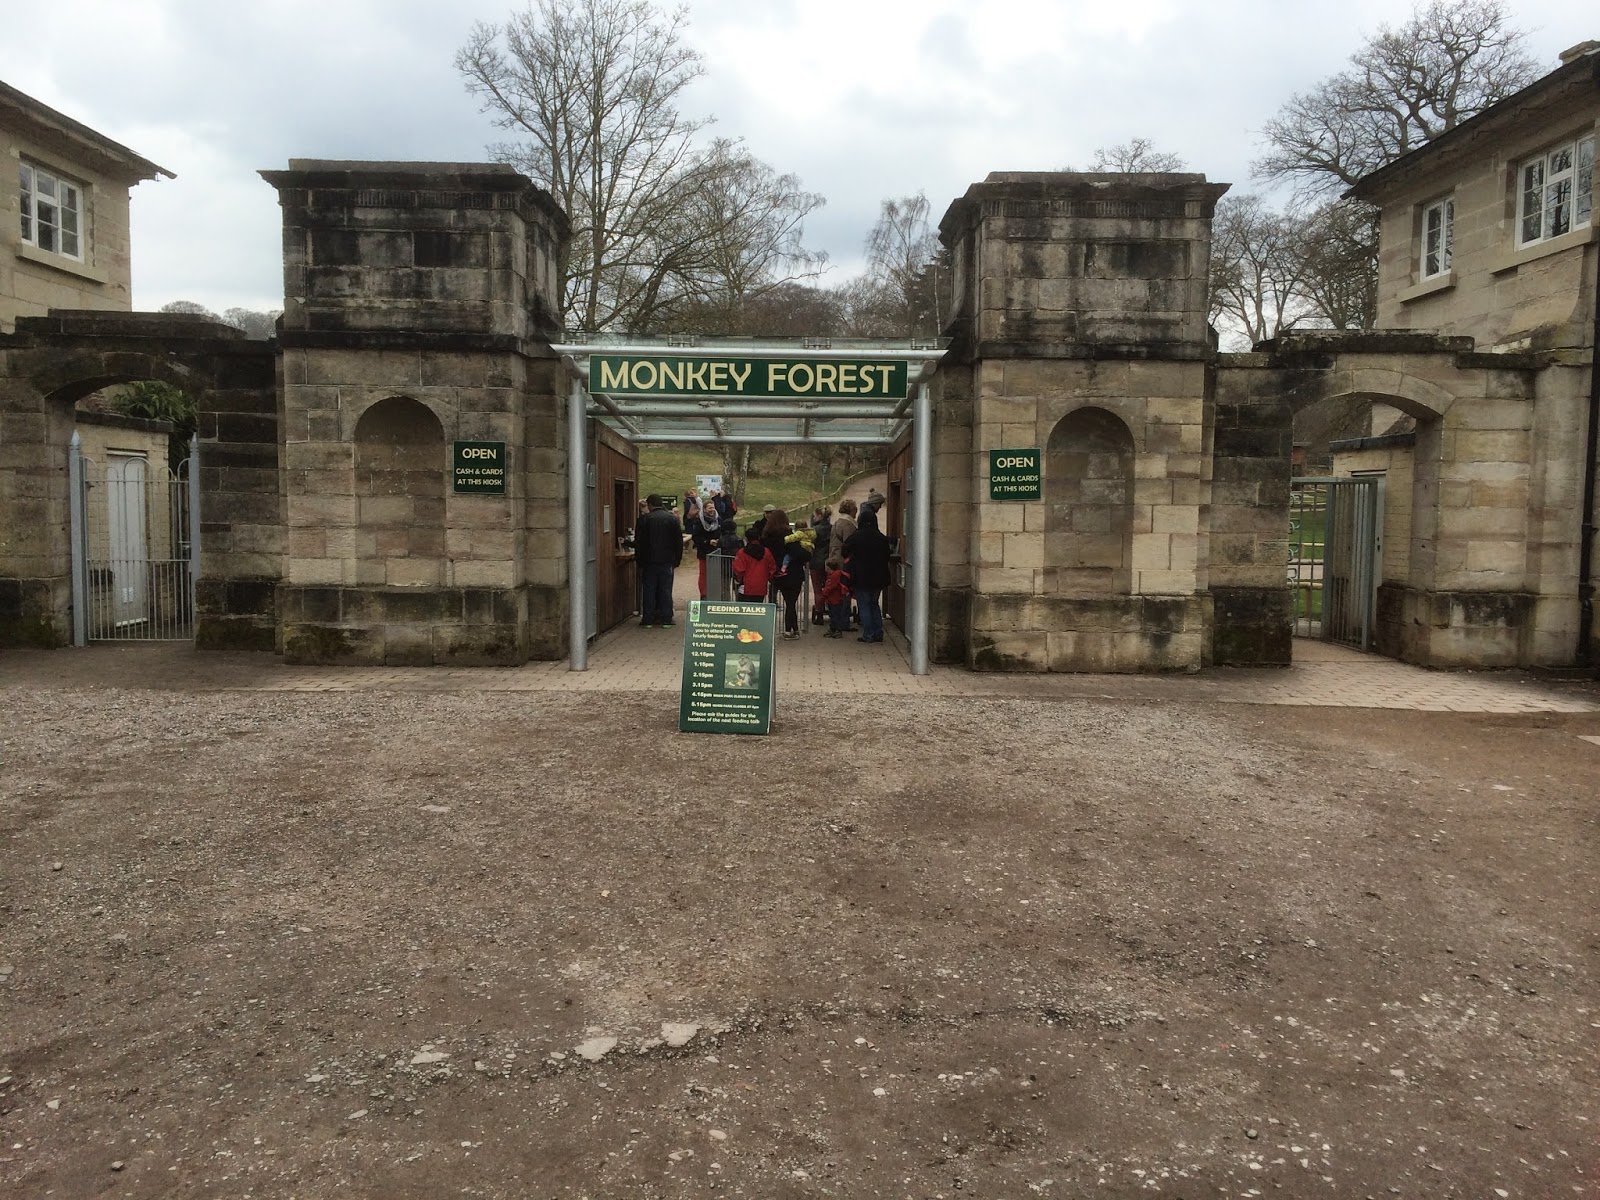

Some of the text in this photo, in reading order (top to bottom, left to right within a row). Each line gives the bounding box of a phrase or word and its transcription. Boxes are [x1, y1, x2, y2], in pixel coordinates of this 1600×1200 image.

[600, 360, 897, 394] MONKEY FOREST
[462, 448, 497, 459] OPEN
[996, 457, 1034, 468] OPEN
[1016, 474, 1039, 482] CARDS
